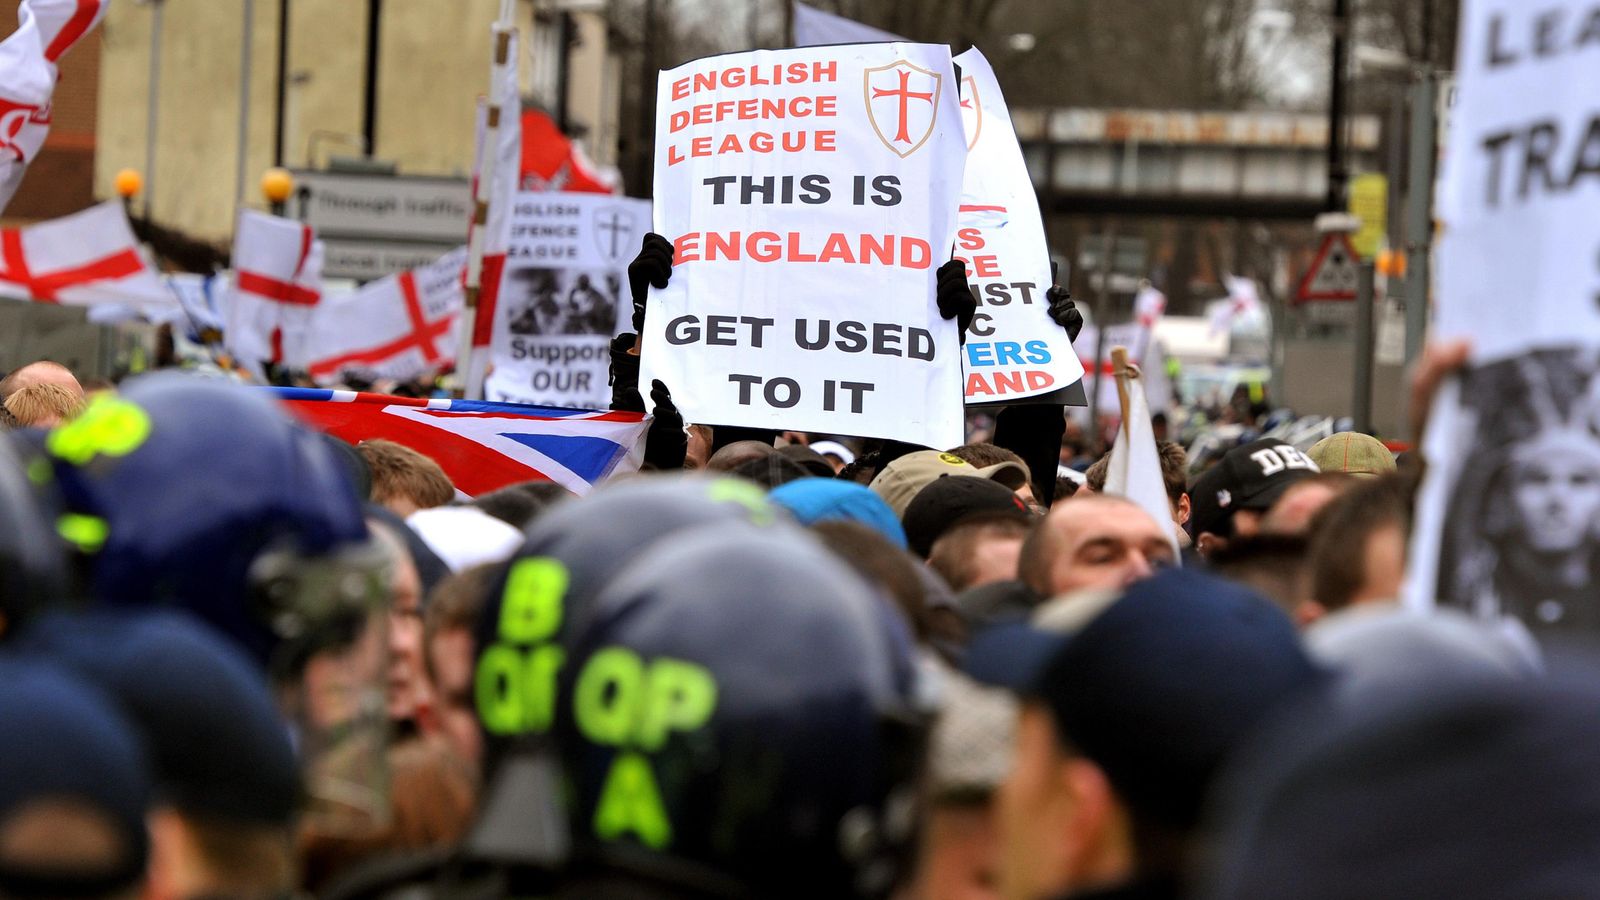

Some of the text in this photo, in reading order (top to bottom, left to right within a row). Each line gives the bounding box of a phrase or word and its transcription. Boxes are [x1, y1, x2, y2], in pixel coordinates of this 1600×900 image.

[671, 61, 837, 101] ENGLISH
[670, 95, 837, 133] DEFENCE
[668, 130, 836, 166] LEAGUE
[703, 175, 902, 206] THIS IS
[507, 245, 577, 259] EAGUE
[673, 231, 932, 270] ENGLAND
[969, 282, 1036, 307] IST
[665, 315, 935, 362] GET USED
[968, 313, 996, 336] C
[511, 338, 610, 366] Suppor
[966, 340, 1051, 367] ERS
[532, 370, 592, 391] OUR
[728, 374, 875, 414] TO IT
[965, 371, 1055, 396] AND
[594, 752, 673, 848] A
